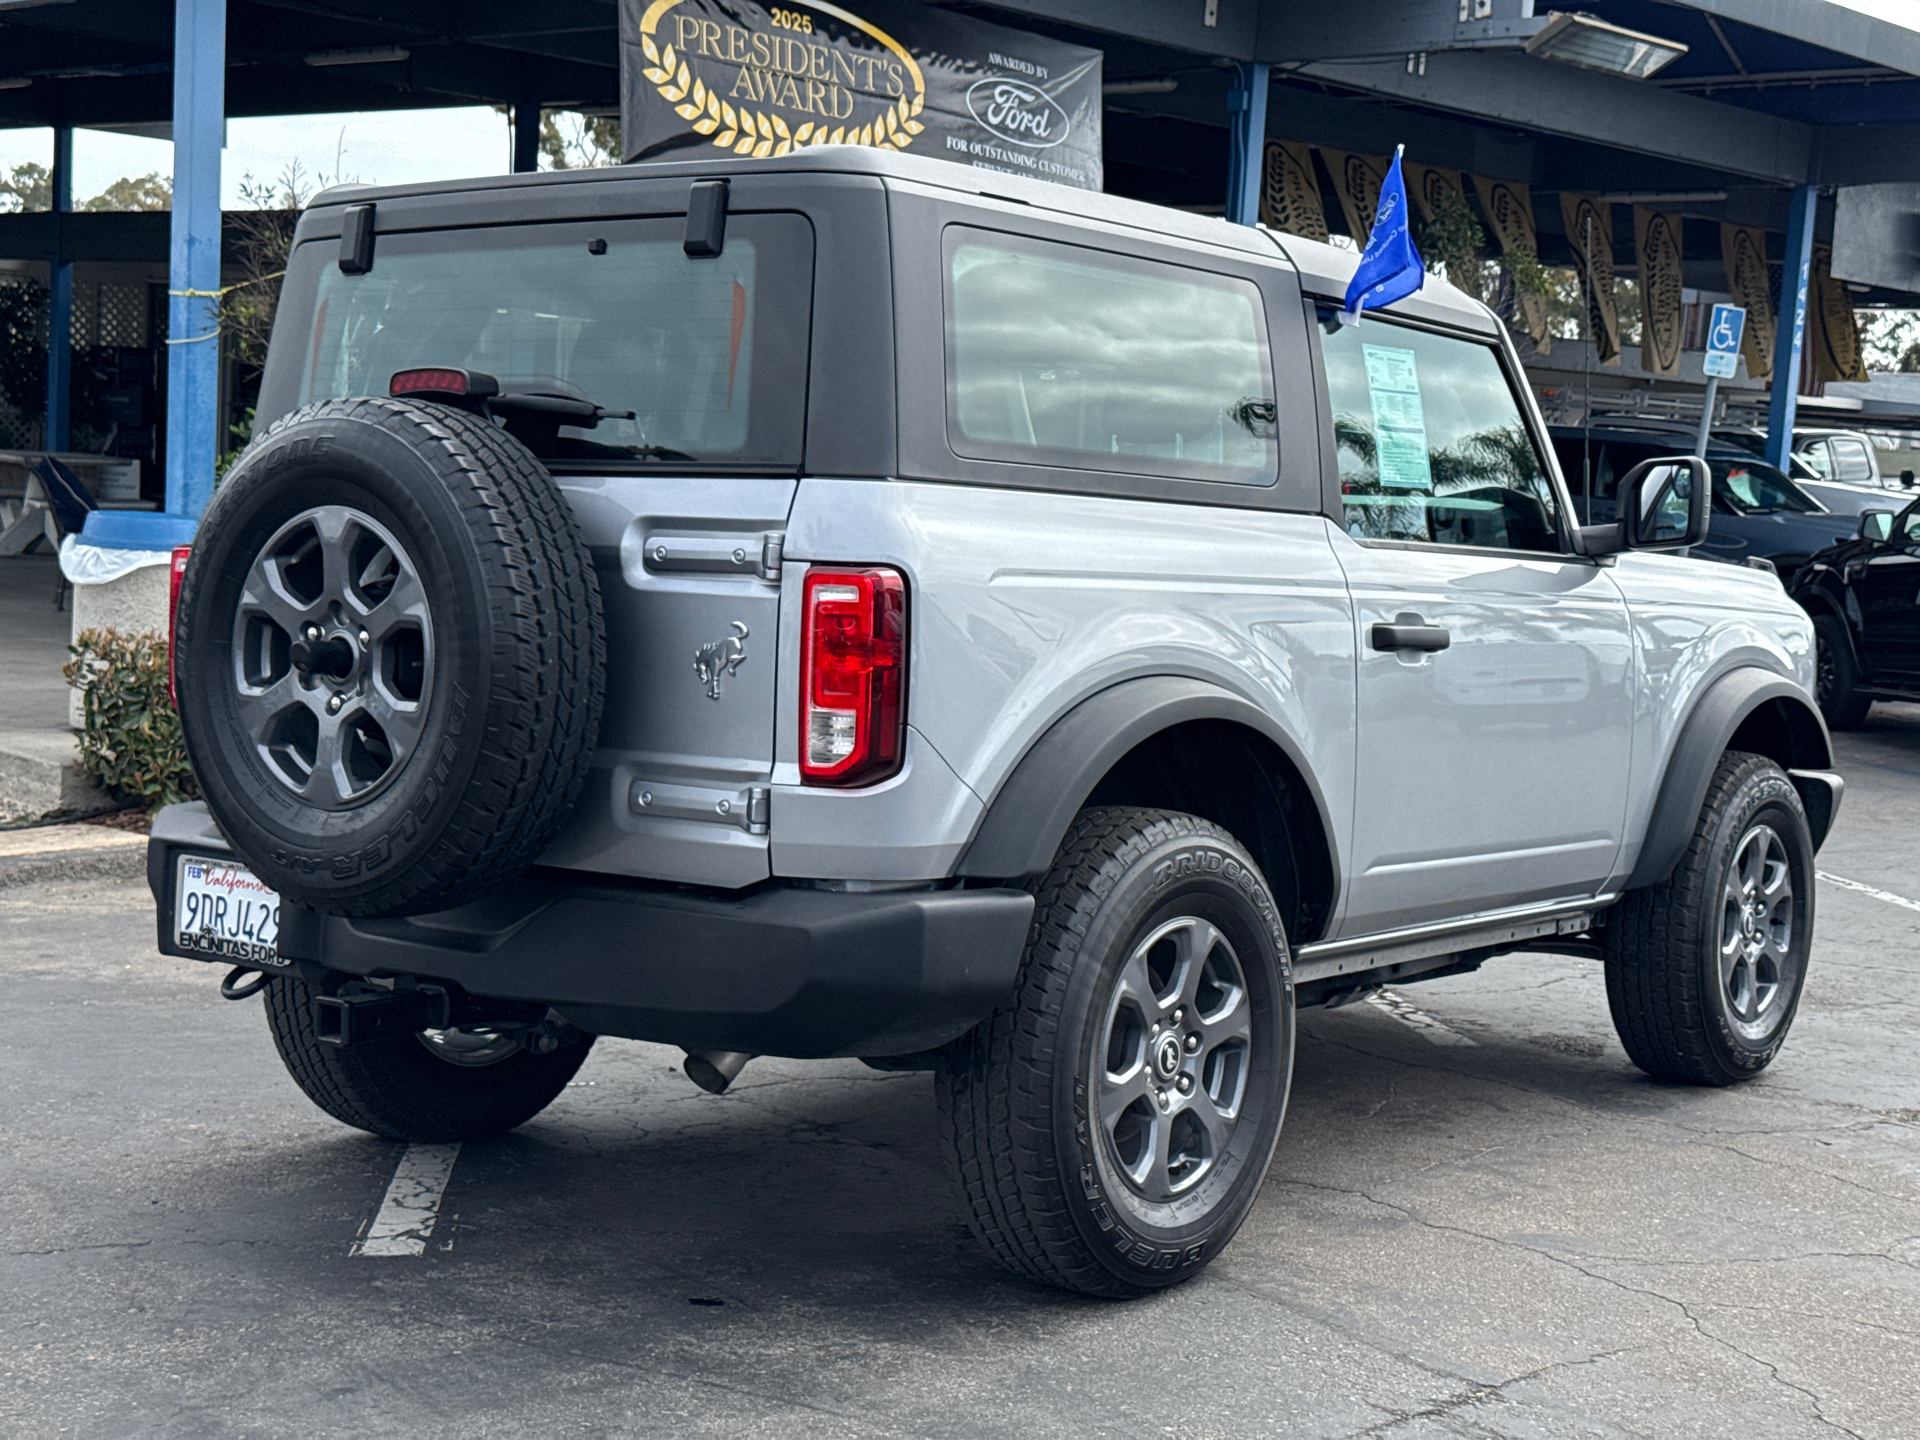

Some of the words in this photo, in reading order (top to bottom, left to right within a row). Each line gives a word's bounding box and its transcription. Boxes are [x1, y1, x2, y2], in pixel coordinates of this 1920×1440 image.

[770, 7, 813, 35] 2025
[673, 14, 904, 97] PRESIDENT'S
[988, 52, 1035, 76] AWARDED
[1036, 66, 1050, 79] BY
[728, 64, 854, 120] AWARD
[987, 84, 1051, 138] Ford
[946, 136, 968, 153] FOR
[969, 142, 1037, 170] OUTSTANDING
[1038, 159, 1087, 183] CUSTOMER
[1794, 262, 1810, 349] 1424
[187, 866, 202, 879] FEB
[205, 866, 274, 895] California
[179, 931, 250, 958] ENCINITAS
[1153, 850, 1294, 1008] BRIDGESTONE
[1079, 1163, 1208, 1269] DUELER
